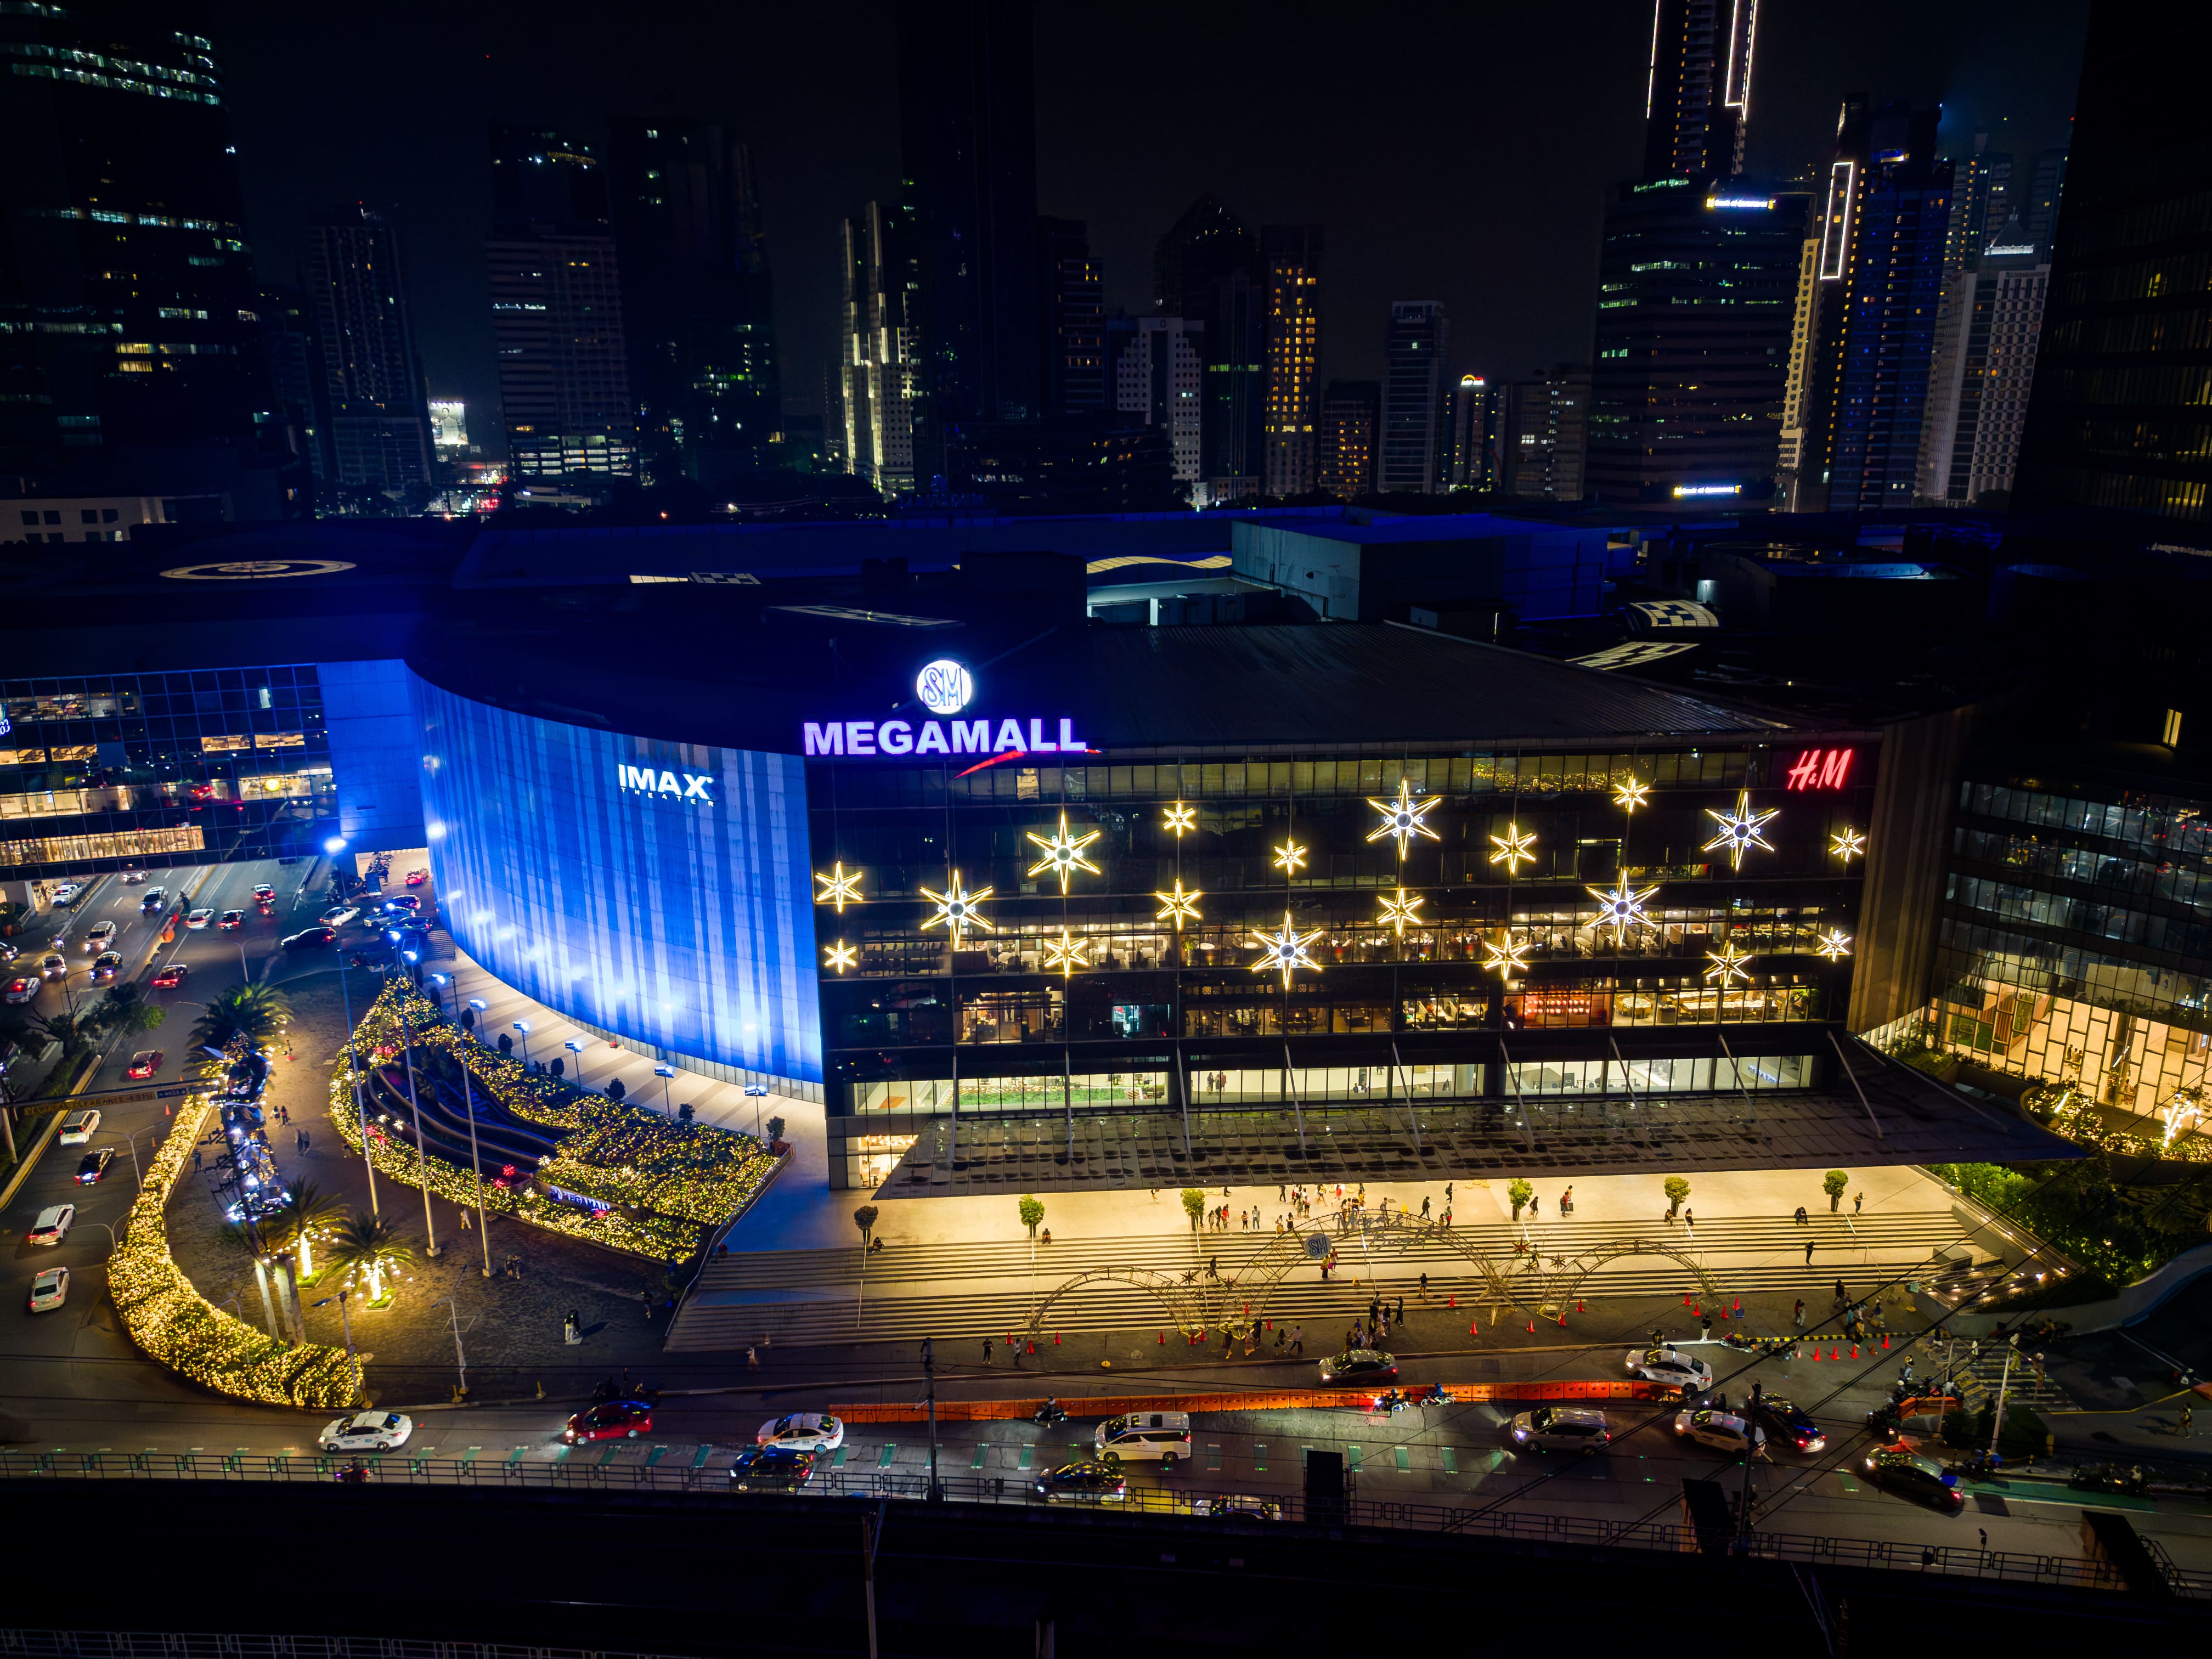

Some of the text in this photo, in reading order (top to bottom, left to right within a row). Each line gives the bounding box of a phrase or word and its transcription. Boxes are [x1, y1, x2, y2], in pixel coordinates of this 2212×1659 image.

[921, 665, 965, 709] SM
[804, 718, 1087, 755] MEGAMALL
[618, 764, 709, 800] IMAX
[1788, 749, 1852, 791] H&M
[620, 787, 714, 807] THEATER
